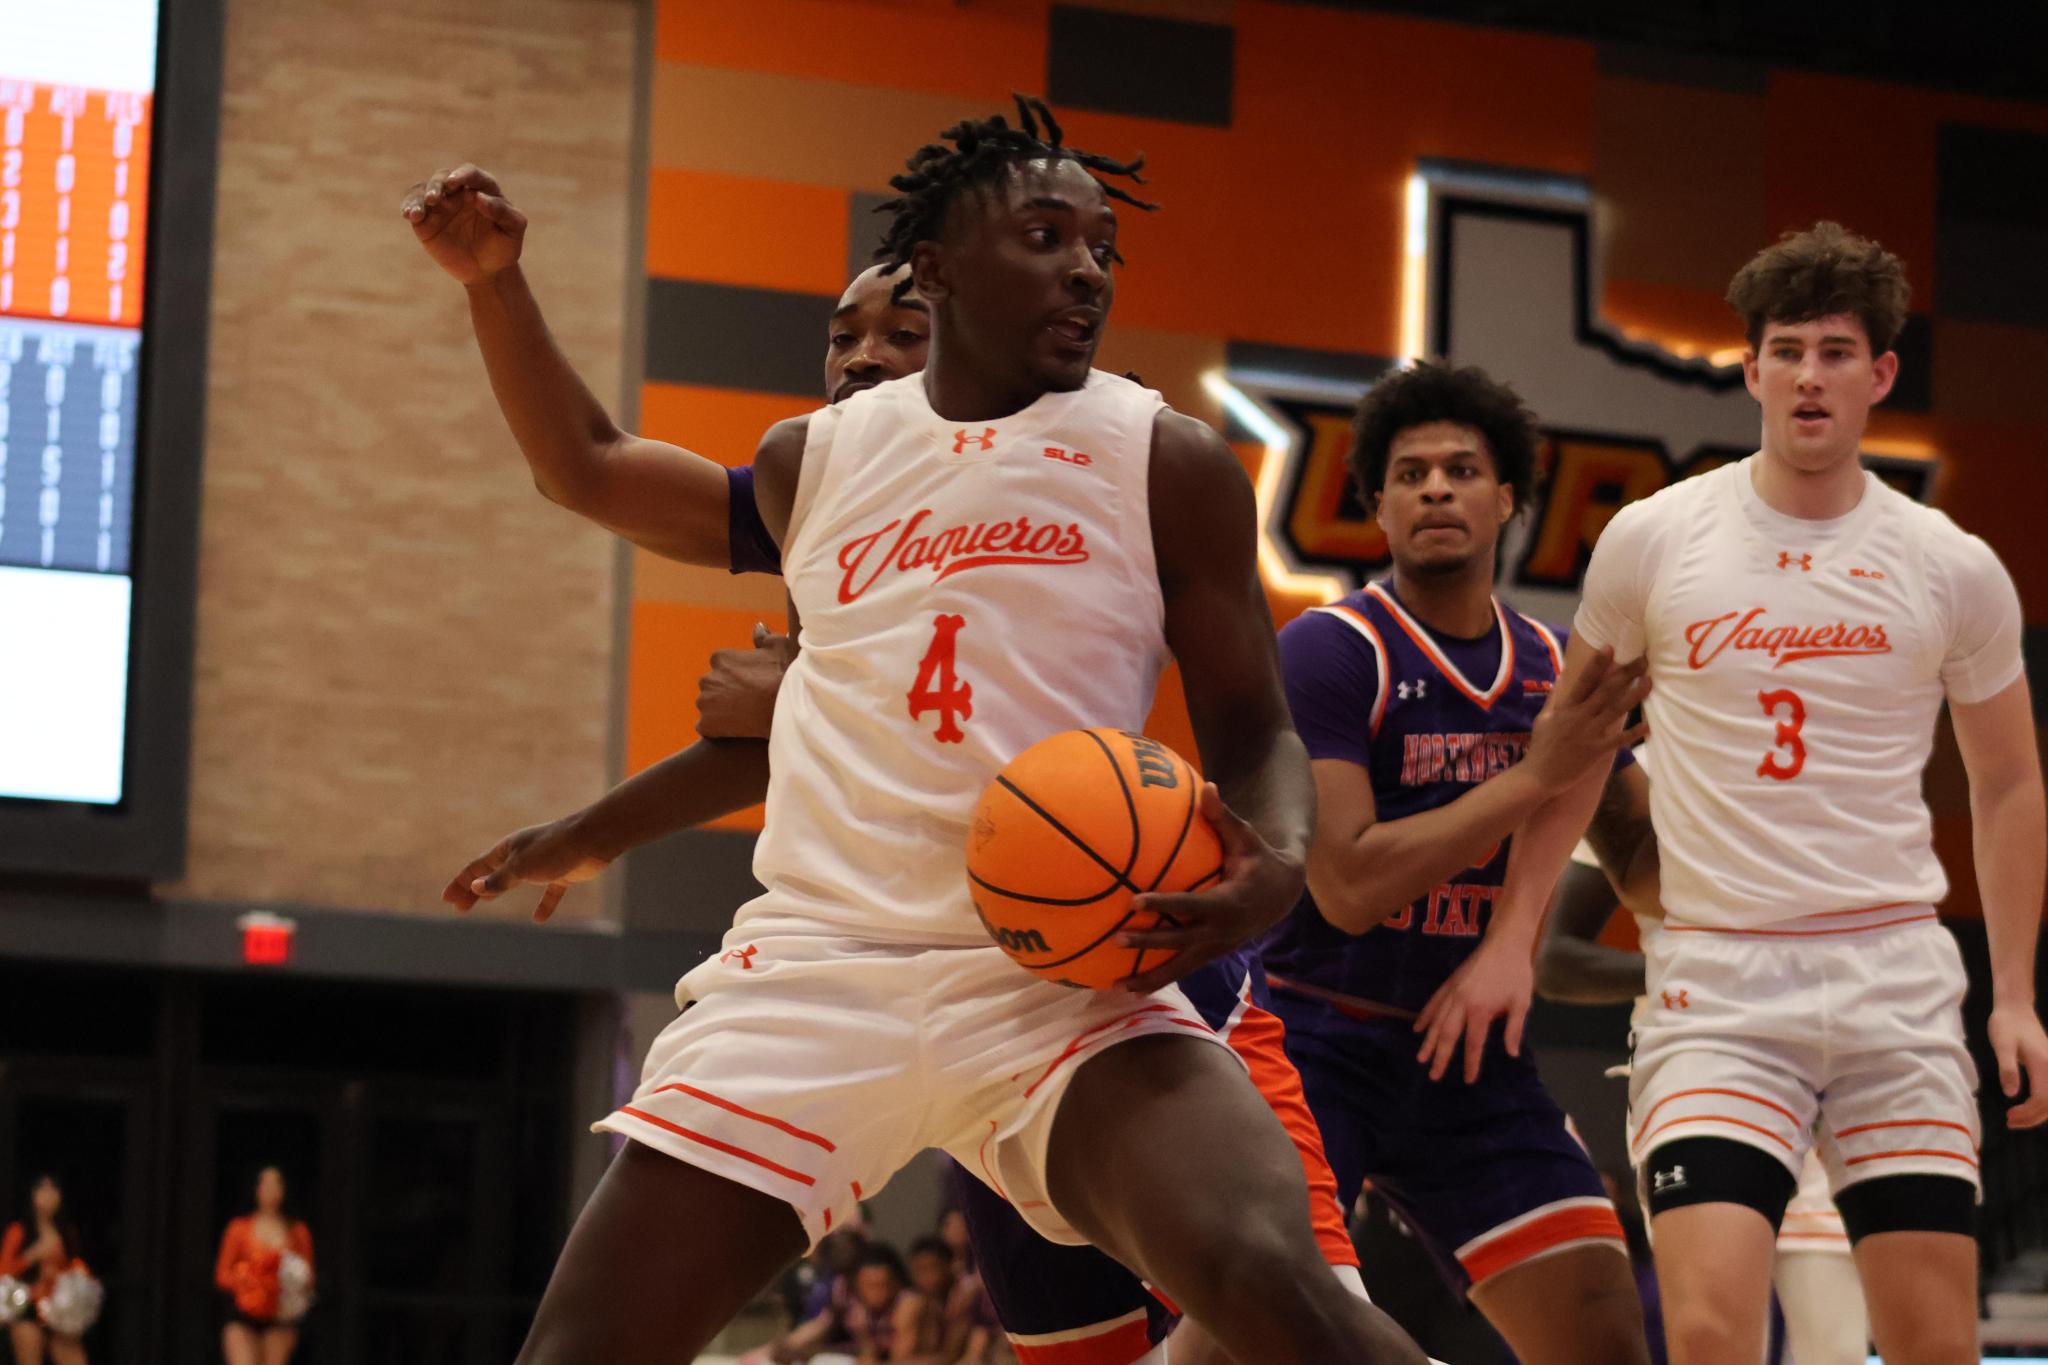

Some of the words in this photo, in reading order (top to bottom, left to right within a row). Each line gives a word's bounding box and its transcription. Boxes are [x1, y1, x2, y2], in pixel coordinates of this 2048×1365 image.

[1043, 447, 1093, 467] SLC
[838, 509, 1089, 605] Vaqueros
[906, 613, 973, 744] 4
[1684, 607, 1893, 671] Vaqueros
[1756, 688, 1807, 781] 3
